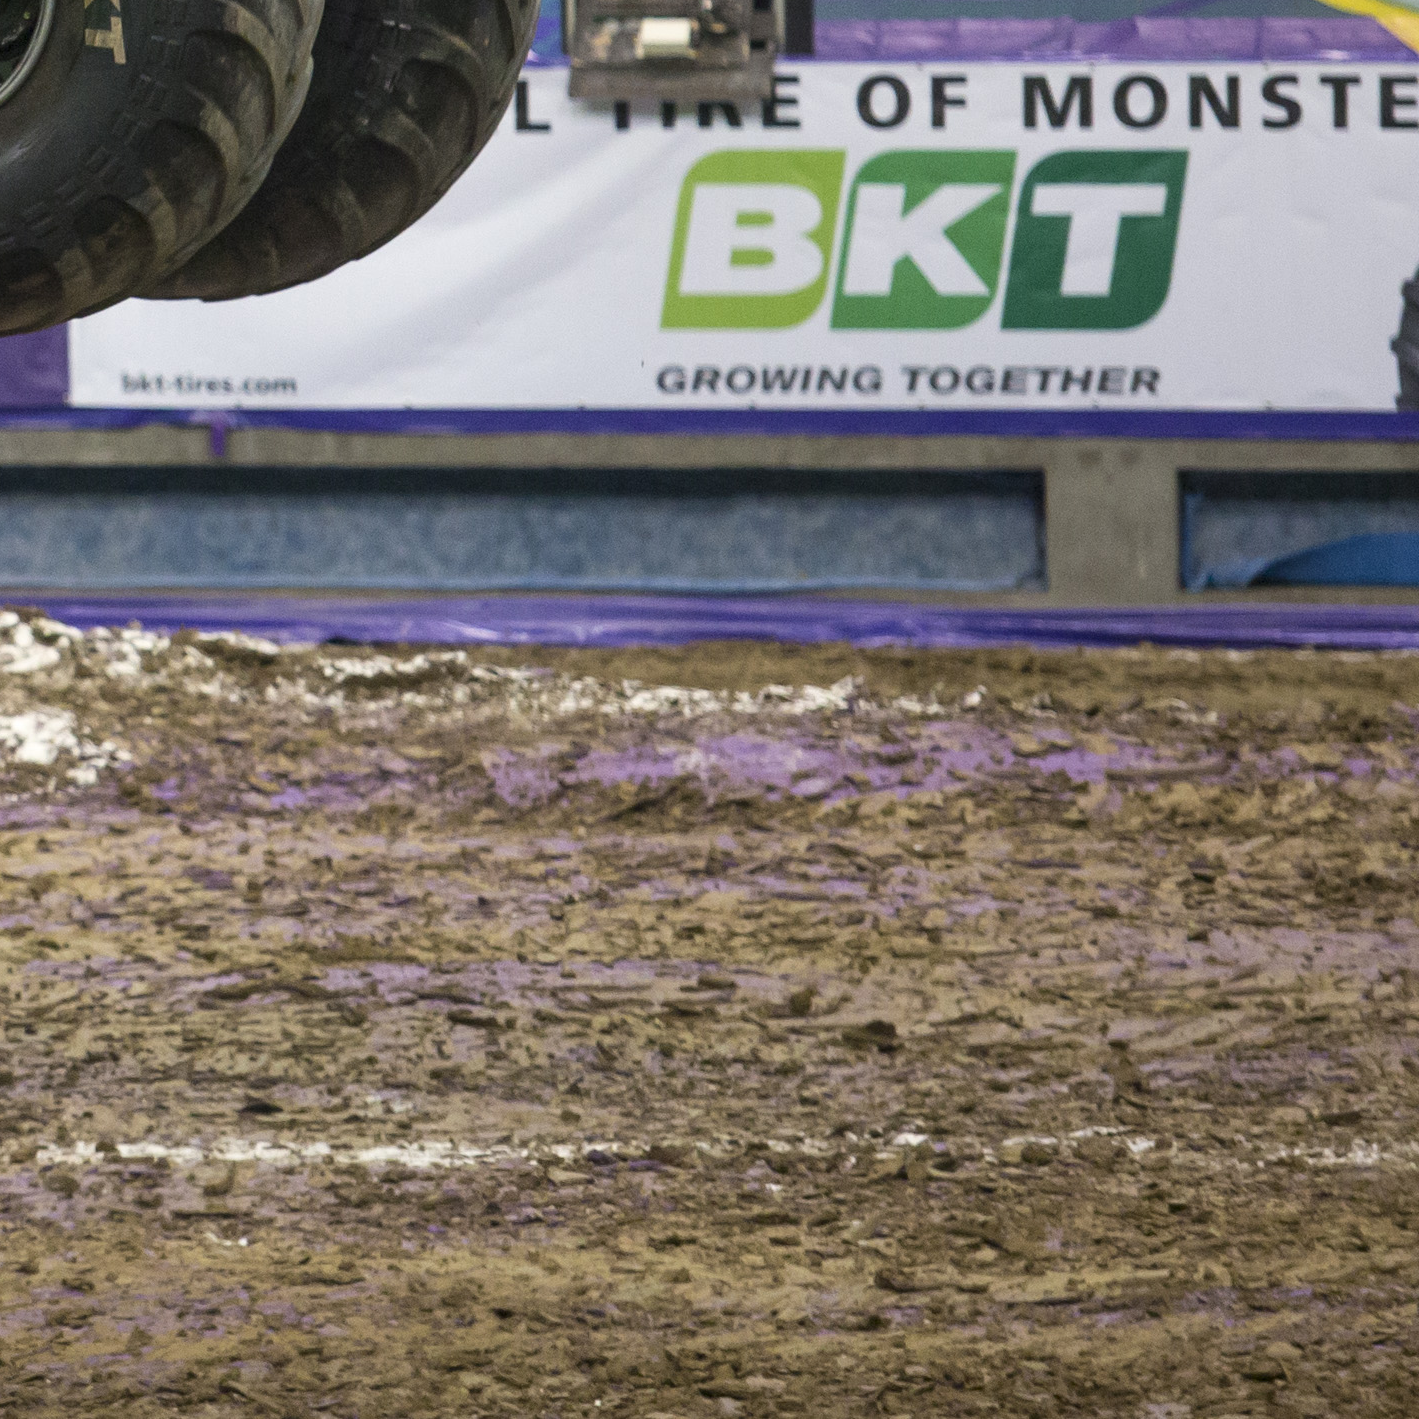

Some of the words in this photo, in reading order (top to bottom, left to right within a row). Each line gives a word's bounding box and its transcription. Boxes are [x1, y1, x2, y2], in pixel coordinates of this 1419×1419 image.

[856, 73, 969, 130] OF
[1021, 73, 1419, 130] MONSTE
[677, 182, 1168, 298] BKT
[120, 369, 298, 395] bkt-tires.com
[655, 363, 884, 396] GROWING
[900, 363, 1161, 396] TOGETHER
